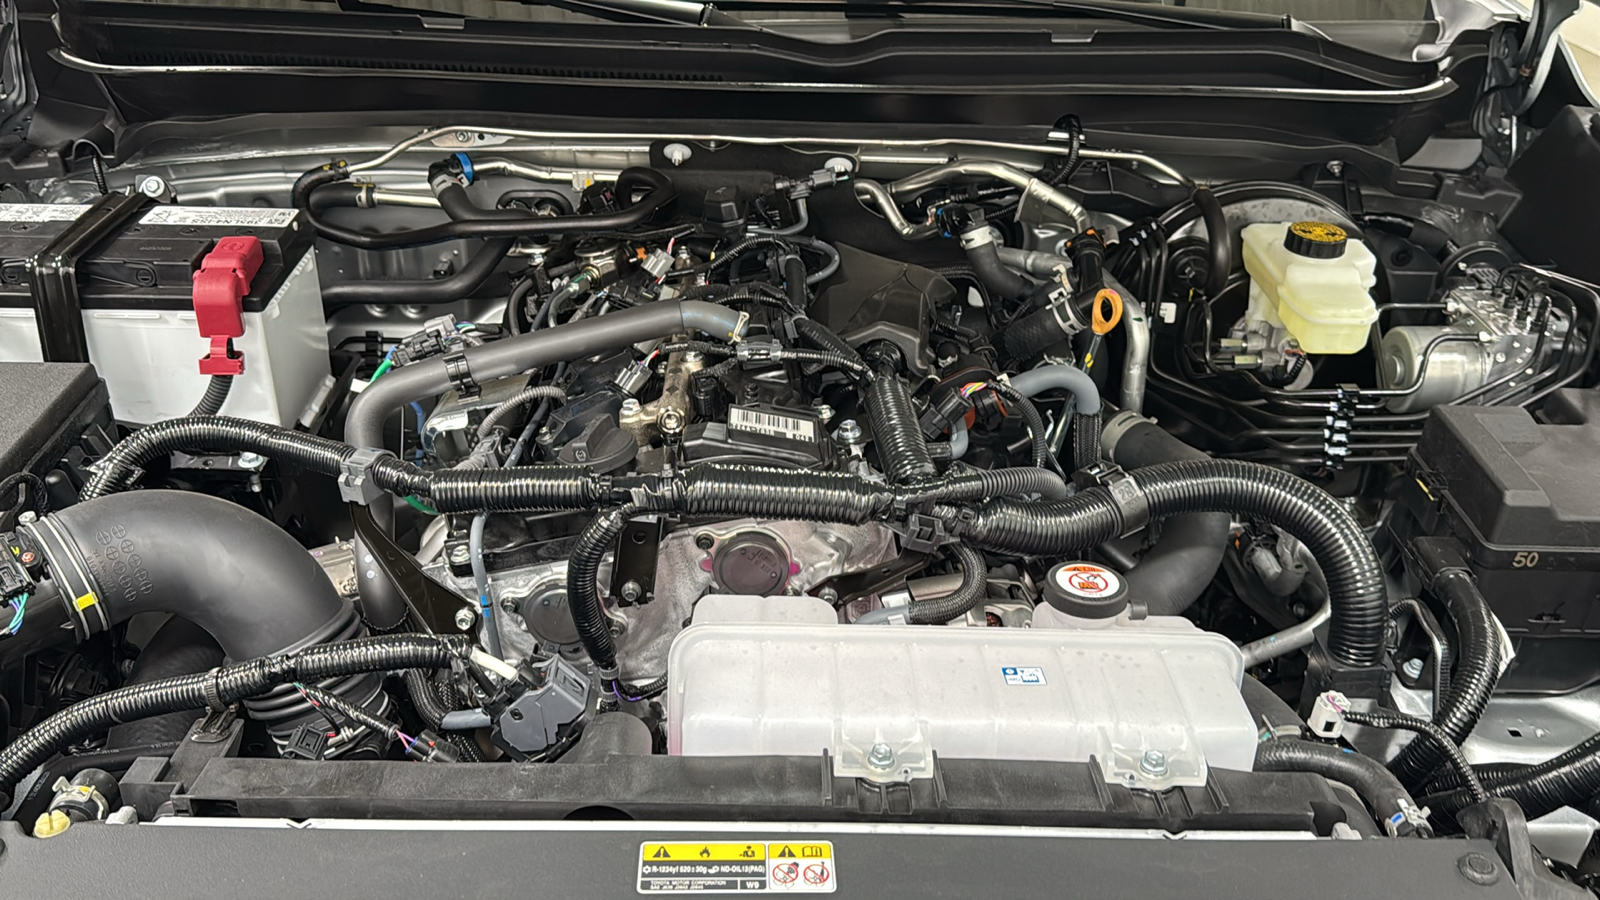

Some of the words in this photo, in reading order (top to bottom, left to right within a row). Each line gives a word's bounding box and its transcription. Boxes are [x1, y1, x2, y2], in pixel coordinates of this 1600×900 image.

[1118, 485, 1135, 502] 28
[1511, 552, 1539, 568] 50
[652, 865, 679, 874] R-1234yf
[745, 880, 760, 889] W9
